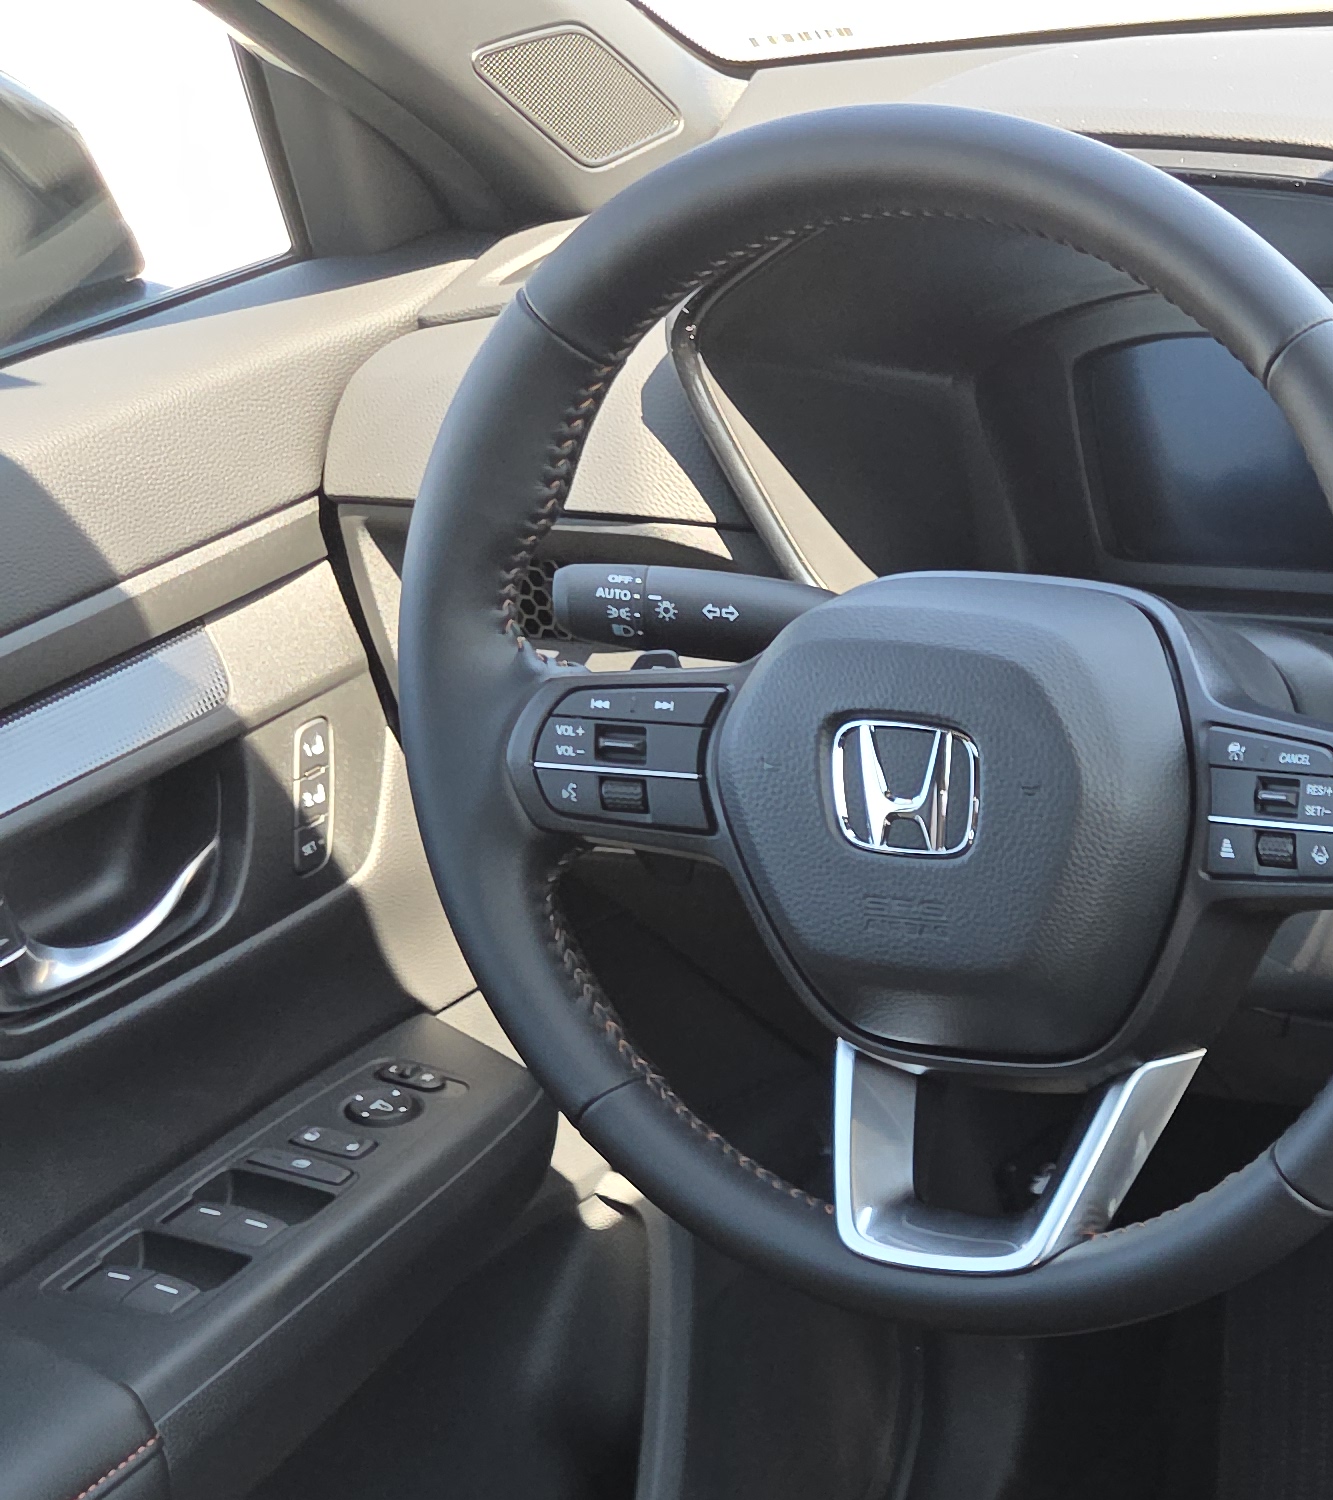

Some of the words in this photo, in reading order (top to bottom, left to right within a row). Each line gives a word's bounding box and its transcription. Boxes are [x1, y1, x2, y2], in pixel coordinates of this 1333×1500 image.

[607, 574, 634, 584] OFF
[595, 587, 632, 601] AUTO
[1278, 752, 1311, 766] CANCEL
